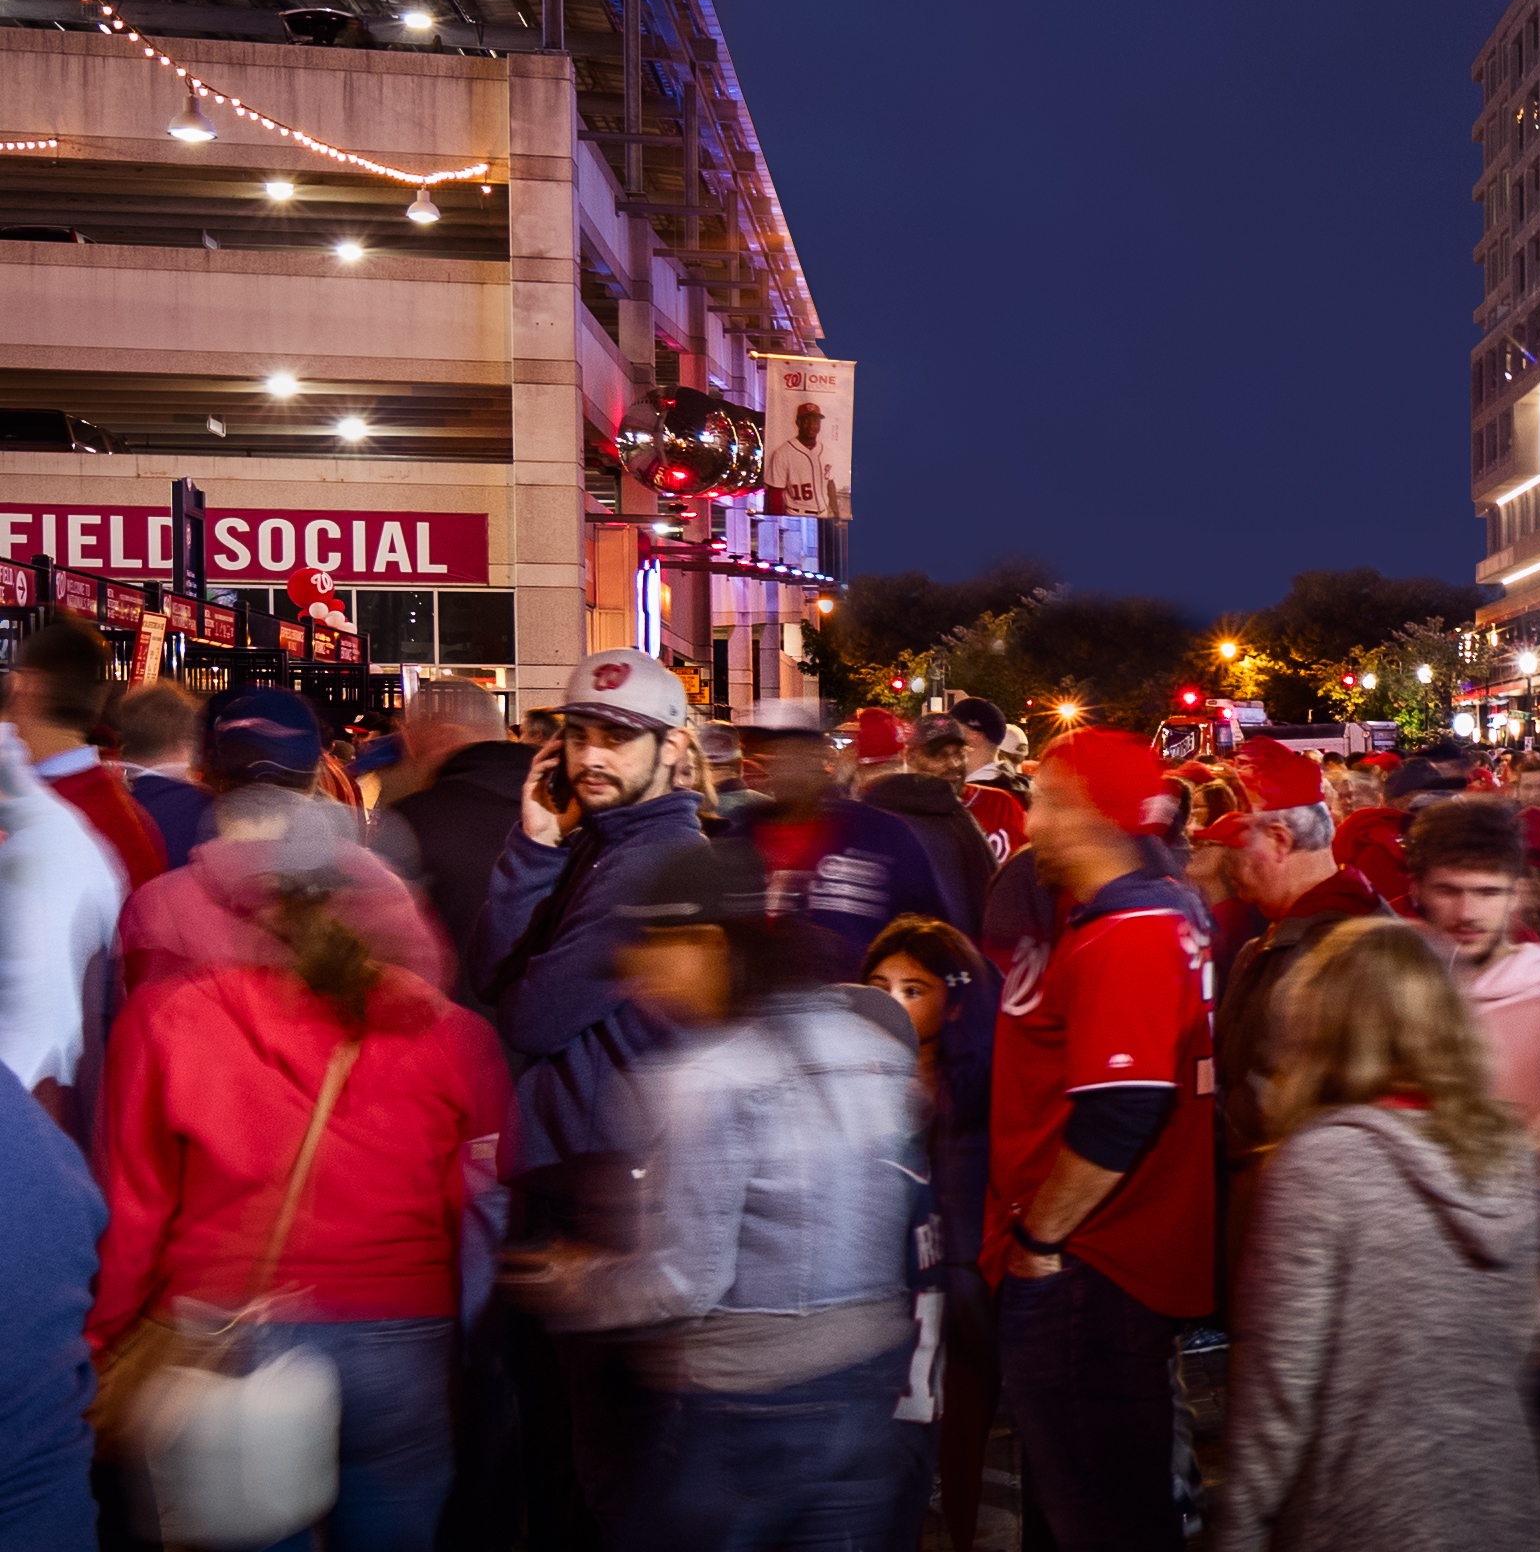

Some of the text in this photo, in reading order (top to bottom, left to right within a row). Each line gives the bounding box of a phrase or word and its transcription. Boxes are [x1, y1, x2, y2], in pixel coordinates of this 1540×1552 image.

[809, 374, 836, 385] ONE
[791, 483, 813, 501] 16
[213, 517, 448, 574] SOCIAL
